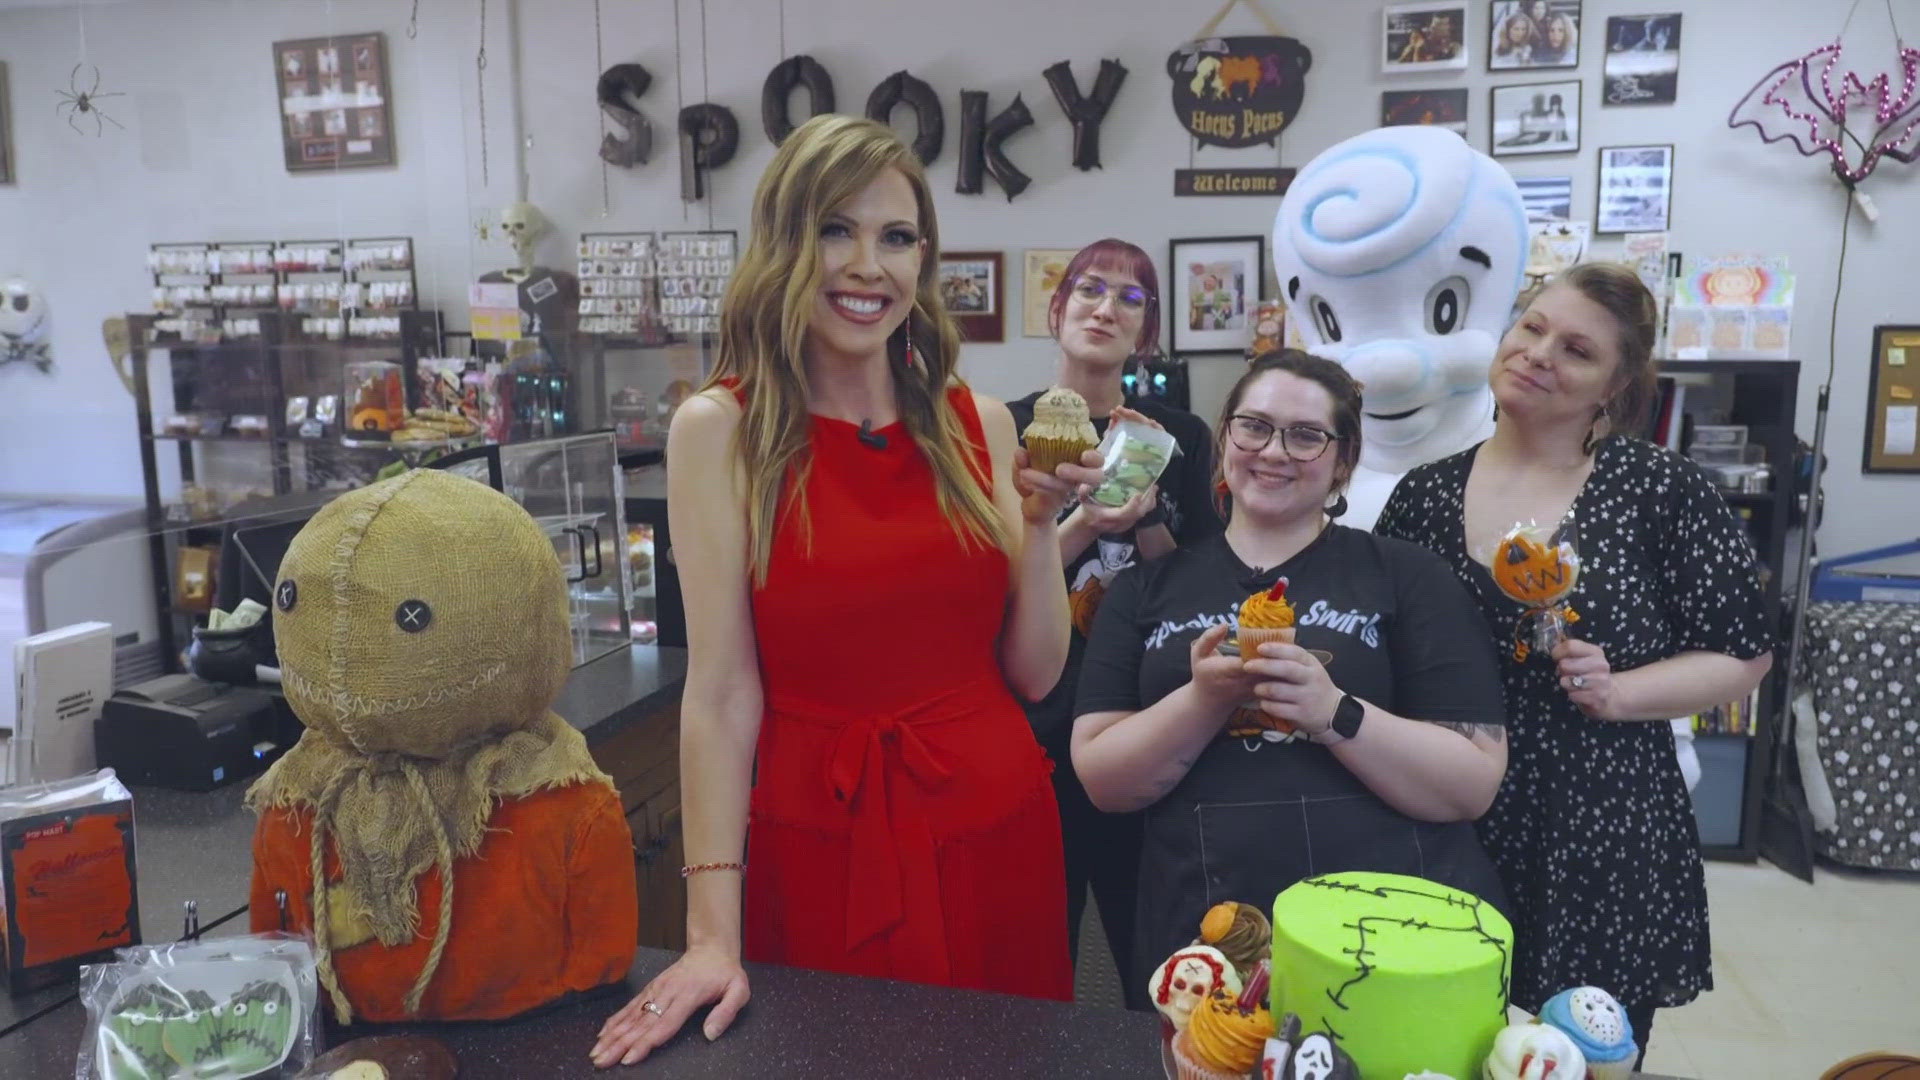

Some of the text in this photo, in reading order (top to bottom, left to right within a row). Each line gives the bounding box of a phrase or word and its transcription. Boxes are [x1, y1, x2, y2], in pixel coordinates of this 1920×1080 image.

[597, 55, 1129, 203] SPOOKY
[1191, 109, 1285, 139] Hocus Pocus
[1193, 173, 1277, 192] Welcome
[1300, 600, 1381, 649] Swirls
[26, 830, 42, 840] POP
